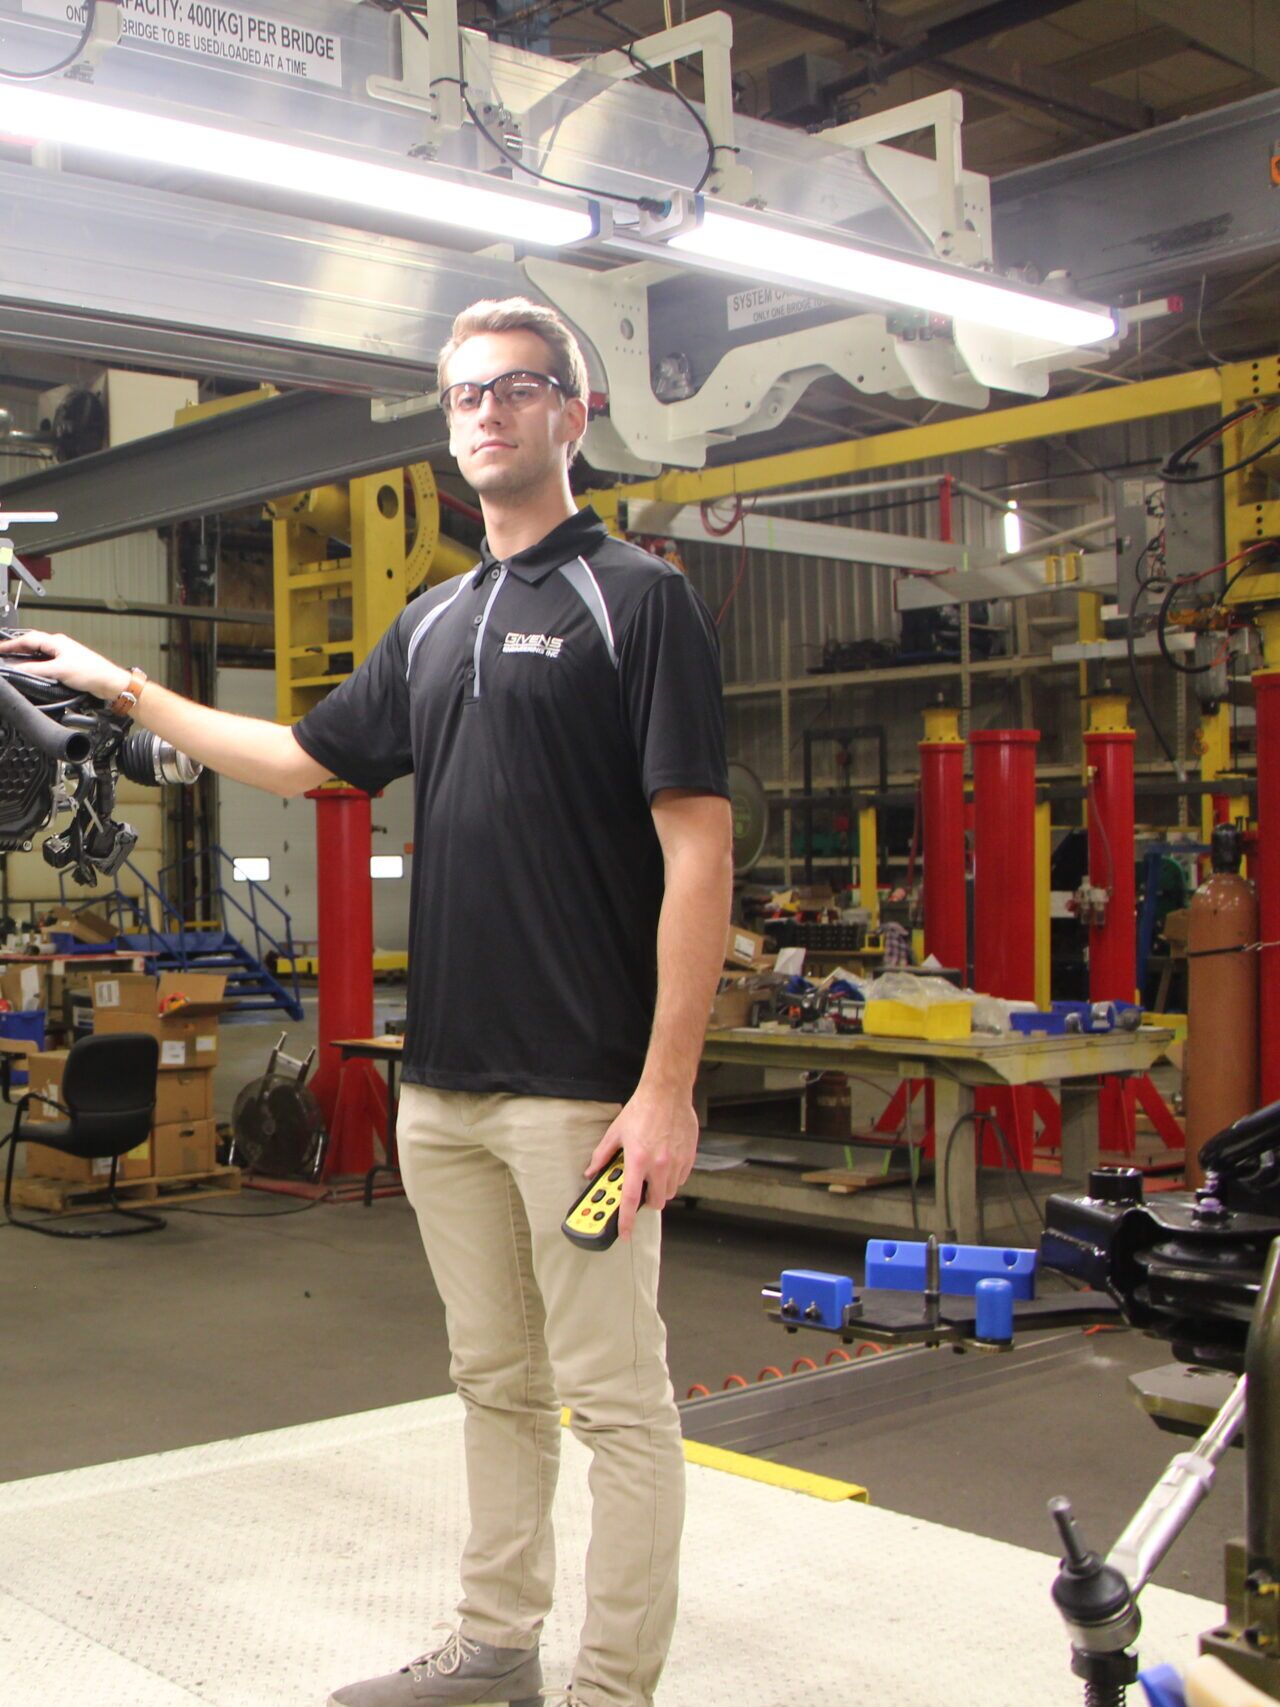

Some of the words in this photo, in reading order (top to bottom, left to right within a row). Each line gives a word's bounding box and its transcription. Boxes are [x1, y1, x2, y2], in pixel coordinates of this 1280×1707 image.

[66, 5, 87, 23] ONL
[122, 18, 159, 40] BRIDGE
[162, 27, 175, 44] TO
[177, 31, 191, 49] BE
[193, 35, 261, 65] USED/LOADED
[263, 53, 275, 69] AT
[277, 55, 284, 70] A
[285, 58, 307, 76] TIME
[120, 0, 182, 22] ACITY:
[187, 2, 244, 43] 400[KG]
[248, 17, 277, 45] PER
[281, 26, 335, 60] BRIDGE
[733, 288, 773, 311] SYSTEM
[504, 632, 564, 650] GIVENS
